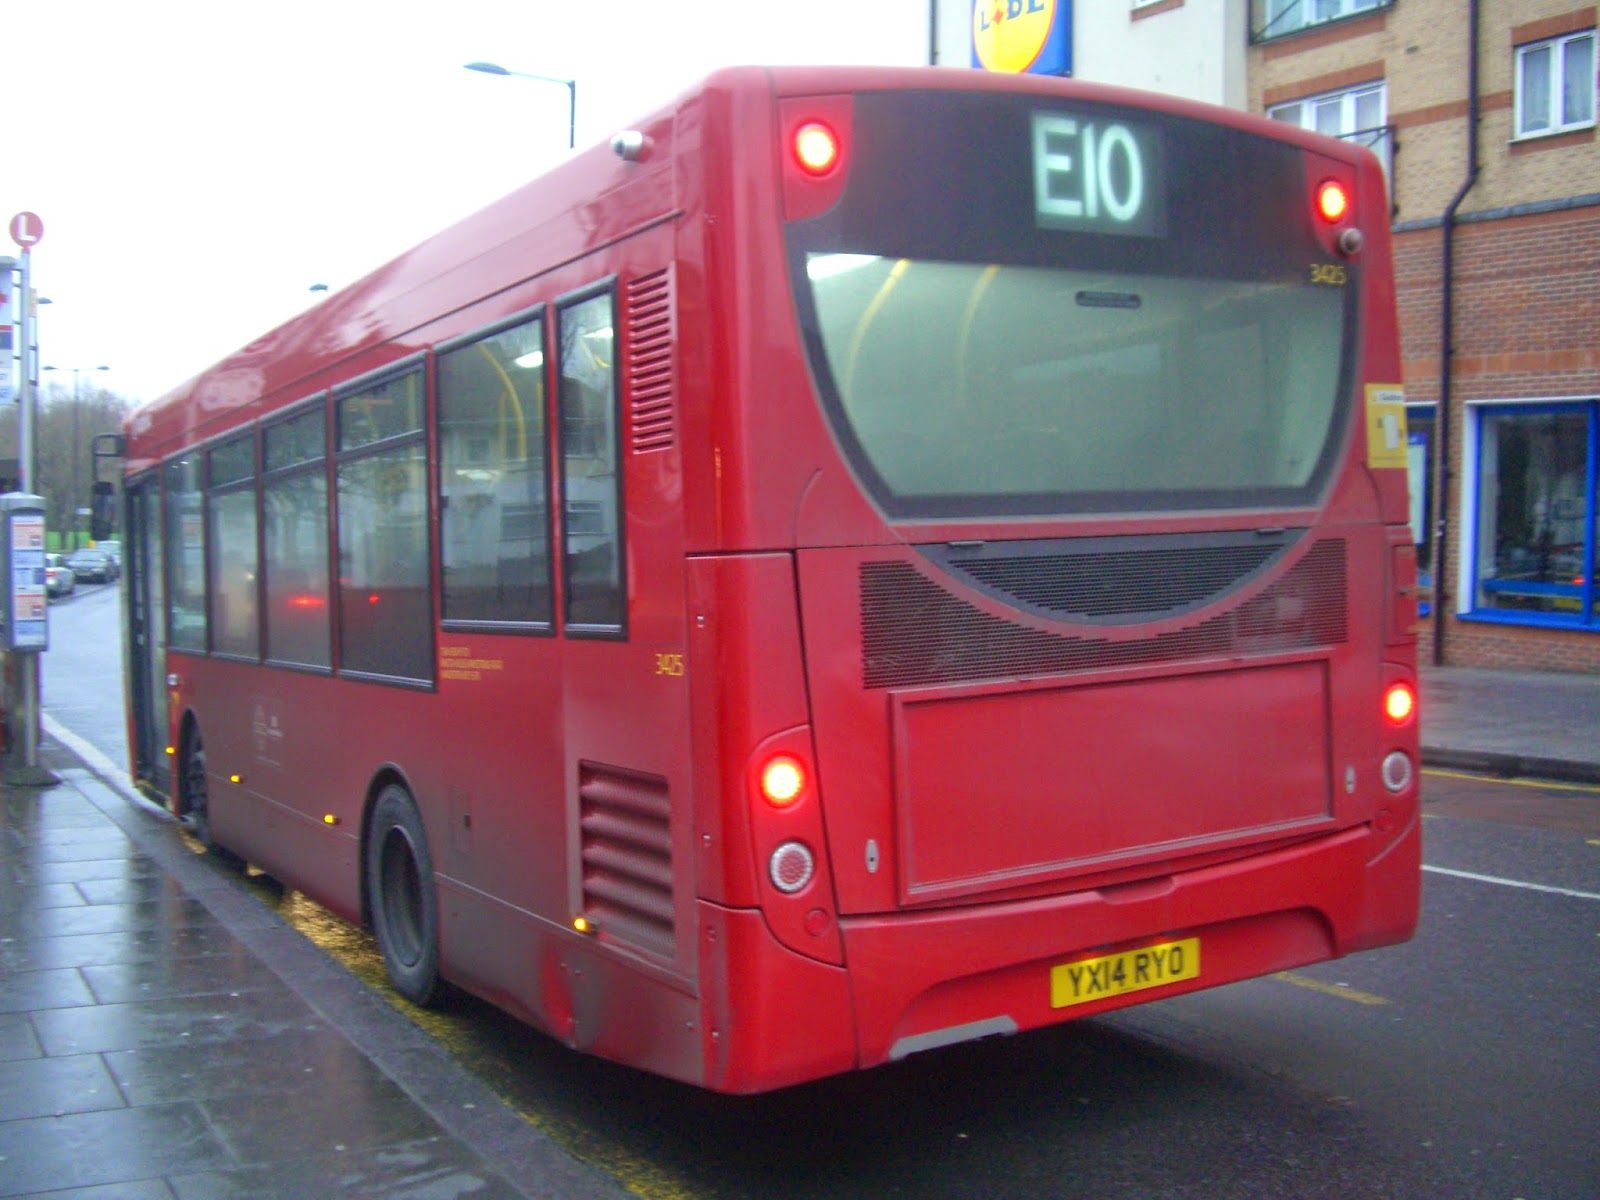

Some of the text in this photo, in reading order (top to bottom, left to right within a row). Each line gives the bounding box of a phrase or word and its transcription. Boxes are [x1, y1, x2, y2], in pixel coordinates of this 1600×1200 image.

[1034, 115, 1144, 221] E10
[18, 214, 36, 241] L
[1068, 958, 1126, 997] YX14
